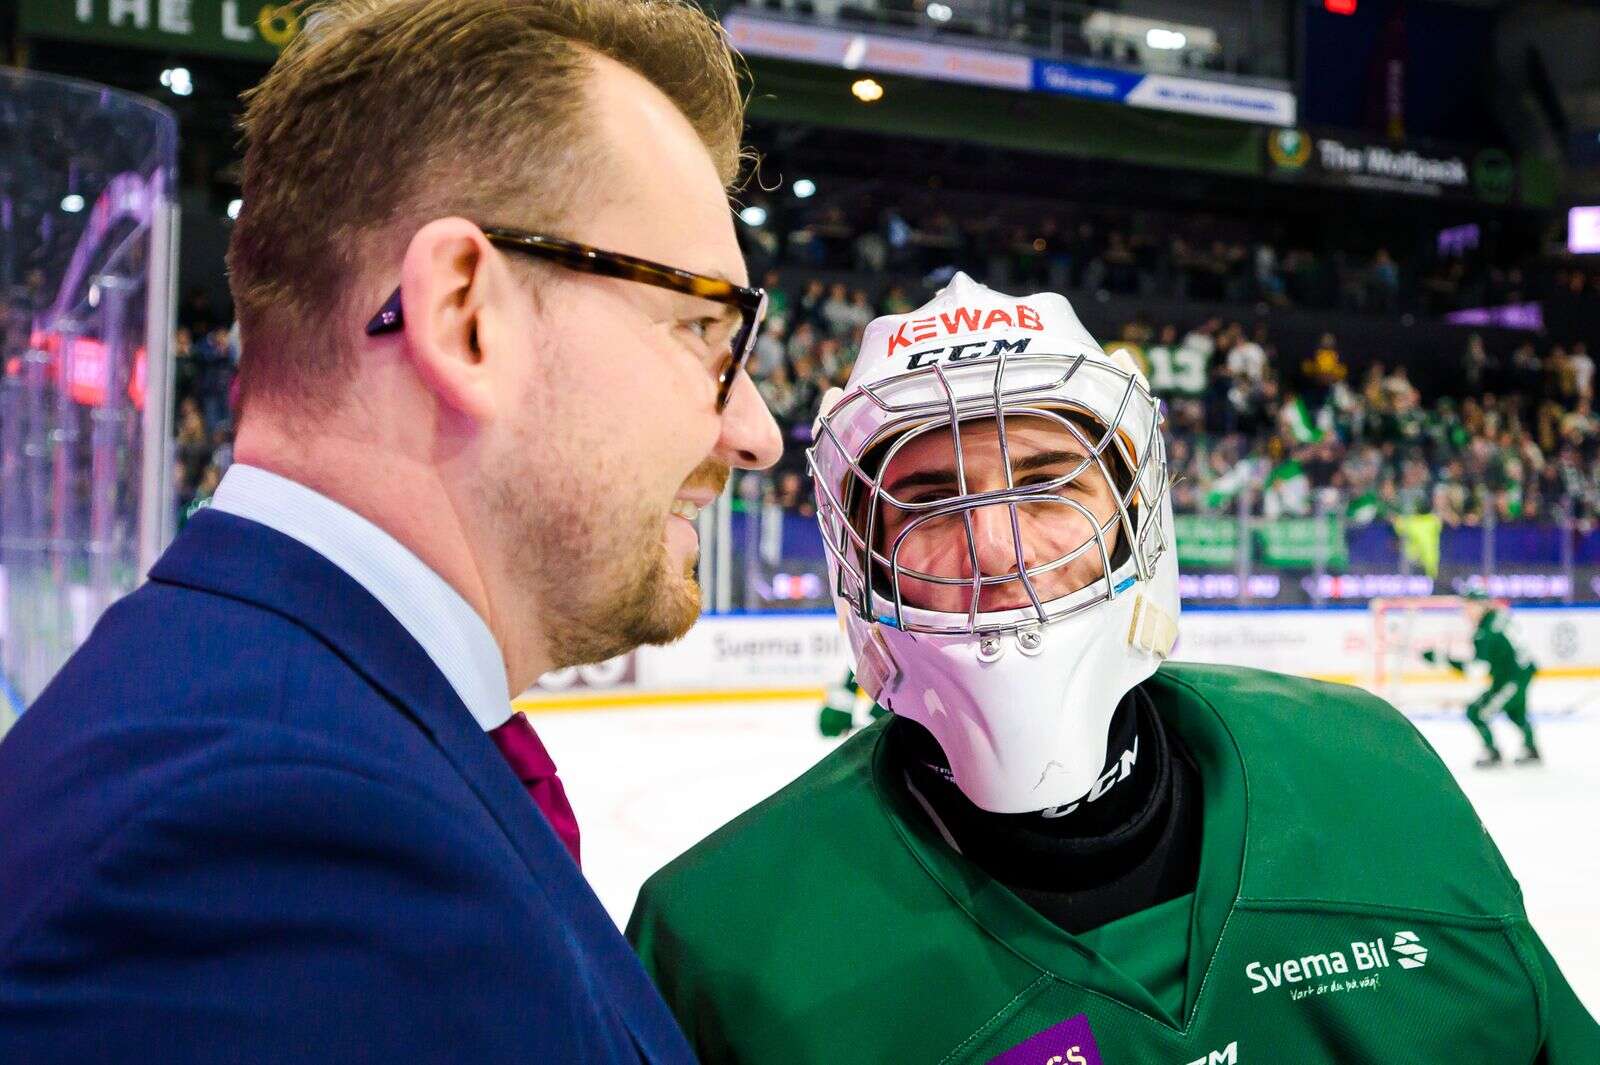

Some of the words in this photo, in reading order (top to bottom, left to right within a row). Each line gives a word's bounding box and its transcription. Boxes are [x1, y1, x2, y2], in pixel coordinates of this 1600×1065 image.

[888, 305, 1044, 358] KEWAB
[907, 338, 1032, 370] CCM
[1245, 951, 1349, 994] Svema
[1350, 937, 1390, 971] Bil
[1290, 985, 1315, 1001] Vart
[1330, 980, 1345, 992] du
